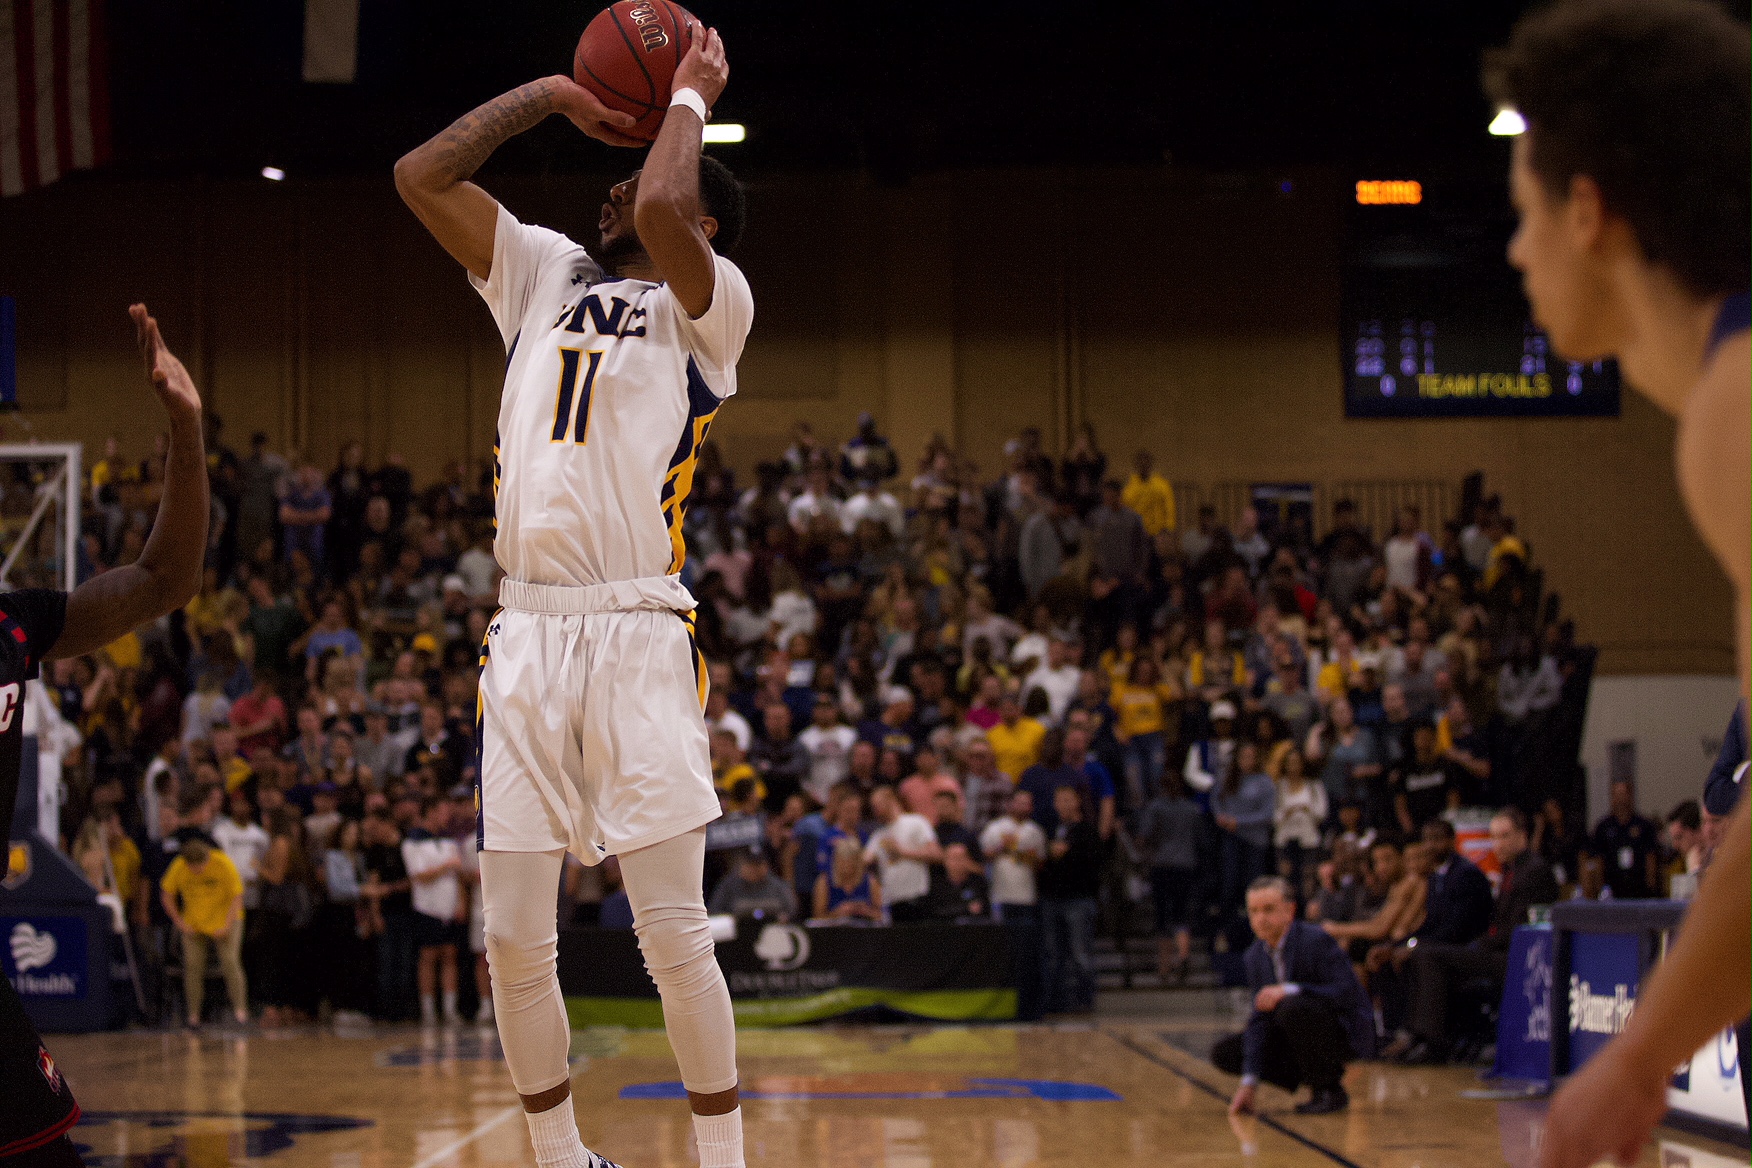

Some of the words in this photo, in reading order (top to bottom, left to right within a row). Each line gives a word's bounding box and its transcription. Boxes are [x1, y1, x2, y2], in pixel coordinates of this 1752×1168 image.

[627, 0, 669, 53] Wils
[549, 346, 606, 446] 11
[1416, 373, 1477, 398] TEAM
[1478, 373, 1553, 398] FOULS
